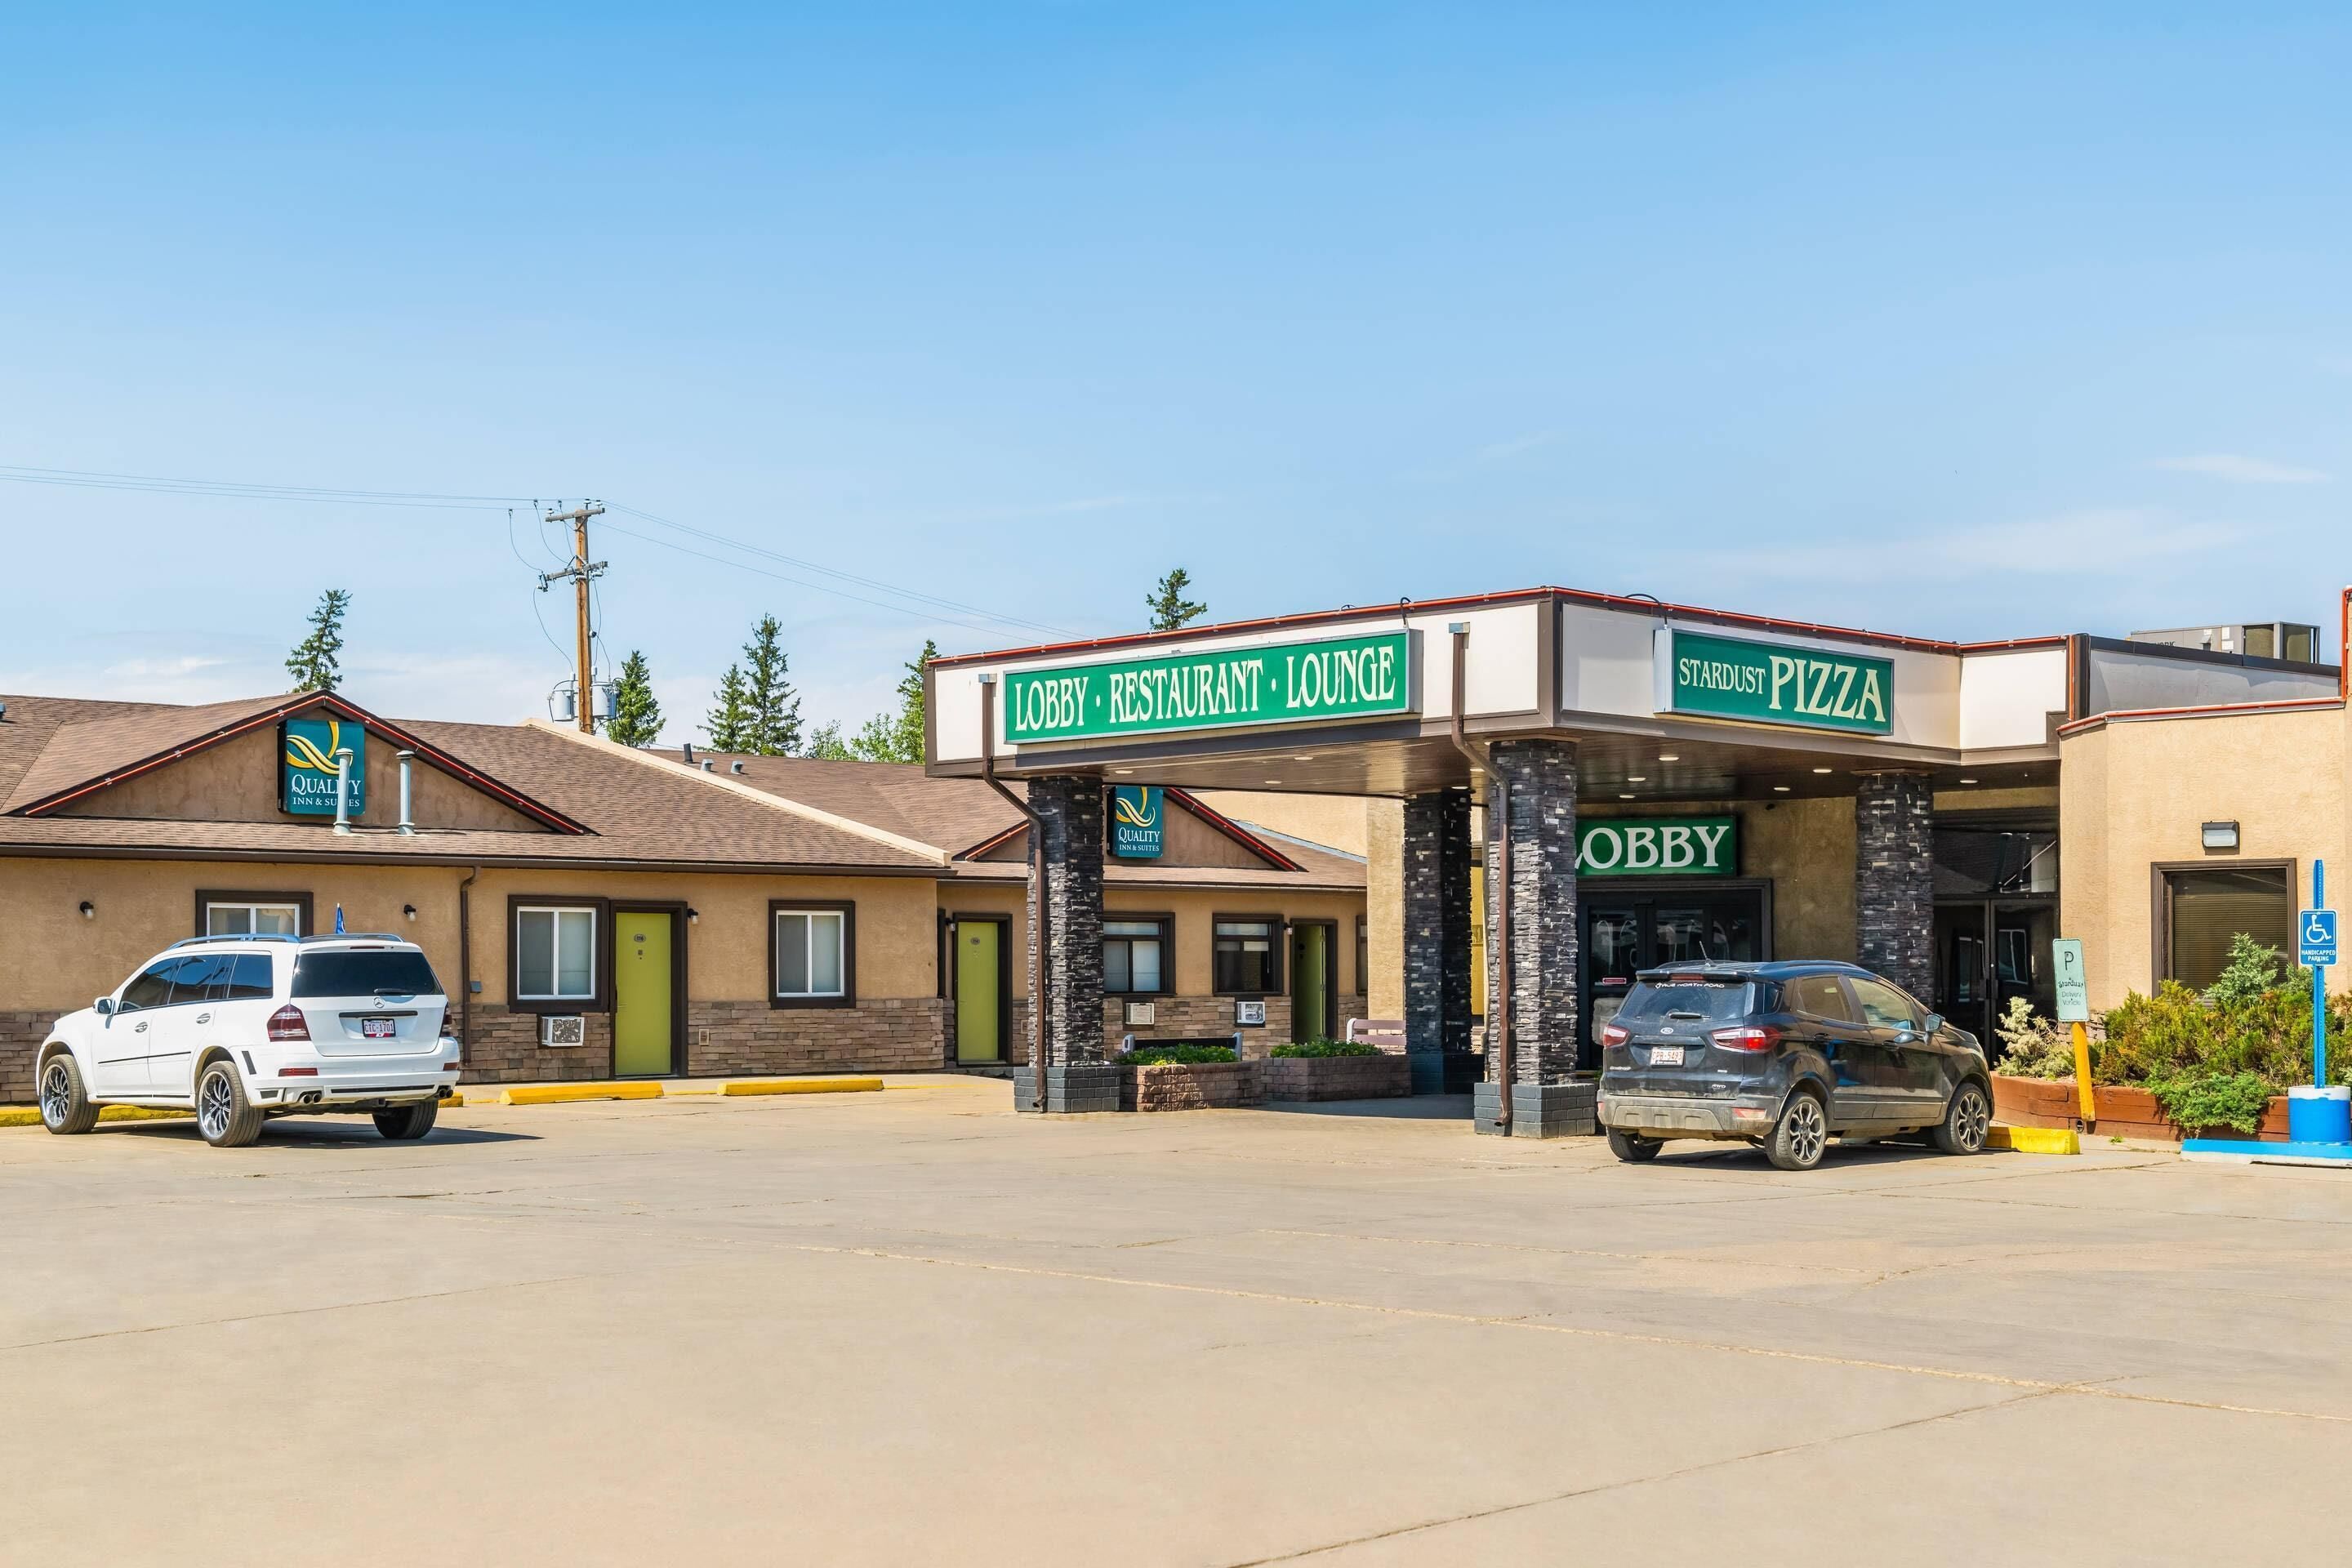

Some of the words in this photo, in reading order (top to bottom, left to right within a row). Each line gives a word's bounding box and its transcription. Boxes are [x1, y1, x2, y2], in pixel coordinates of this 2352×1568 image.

[1015, 676, 1089, 732] LOBBY
[1109, 659, 1263, 724] RESTAURANT
[1286, 644, 1396, 709] LOUNGE
[1679, 657, 1766, 694] STARDUST
[1769, 655, 1886, 722] PIZZA
[293, 797, 313, 805] INN
[324, 799, 360, 807] SUES
[1118, 826, 1160, 844] QUALITY
[1575, 826, 1730, 869] OBBY
[2065, 951, 2074, 970] P
